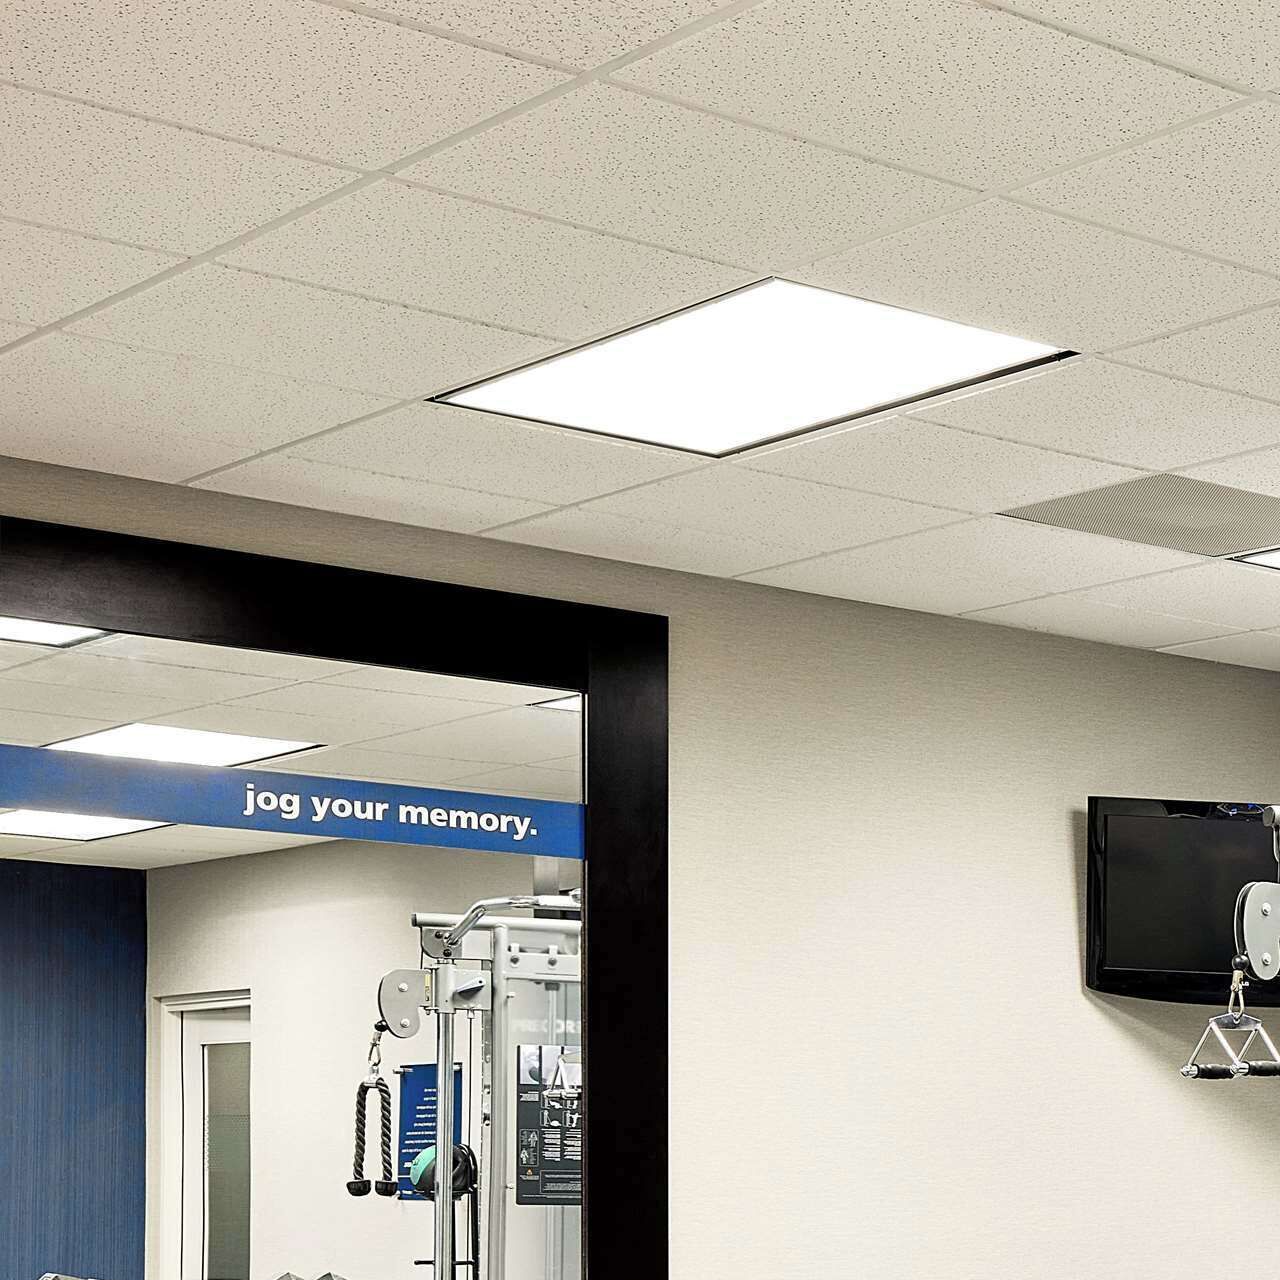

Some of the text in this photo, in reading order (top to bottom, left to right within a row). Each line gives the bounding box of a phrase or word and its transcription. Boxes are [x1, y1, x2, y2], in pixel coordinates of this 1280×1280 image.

[243, 783, 537, 841] jog your memory.
